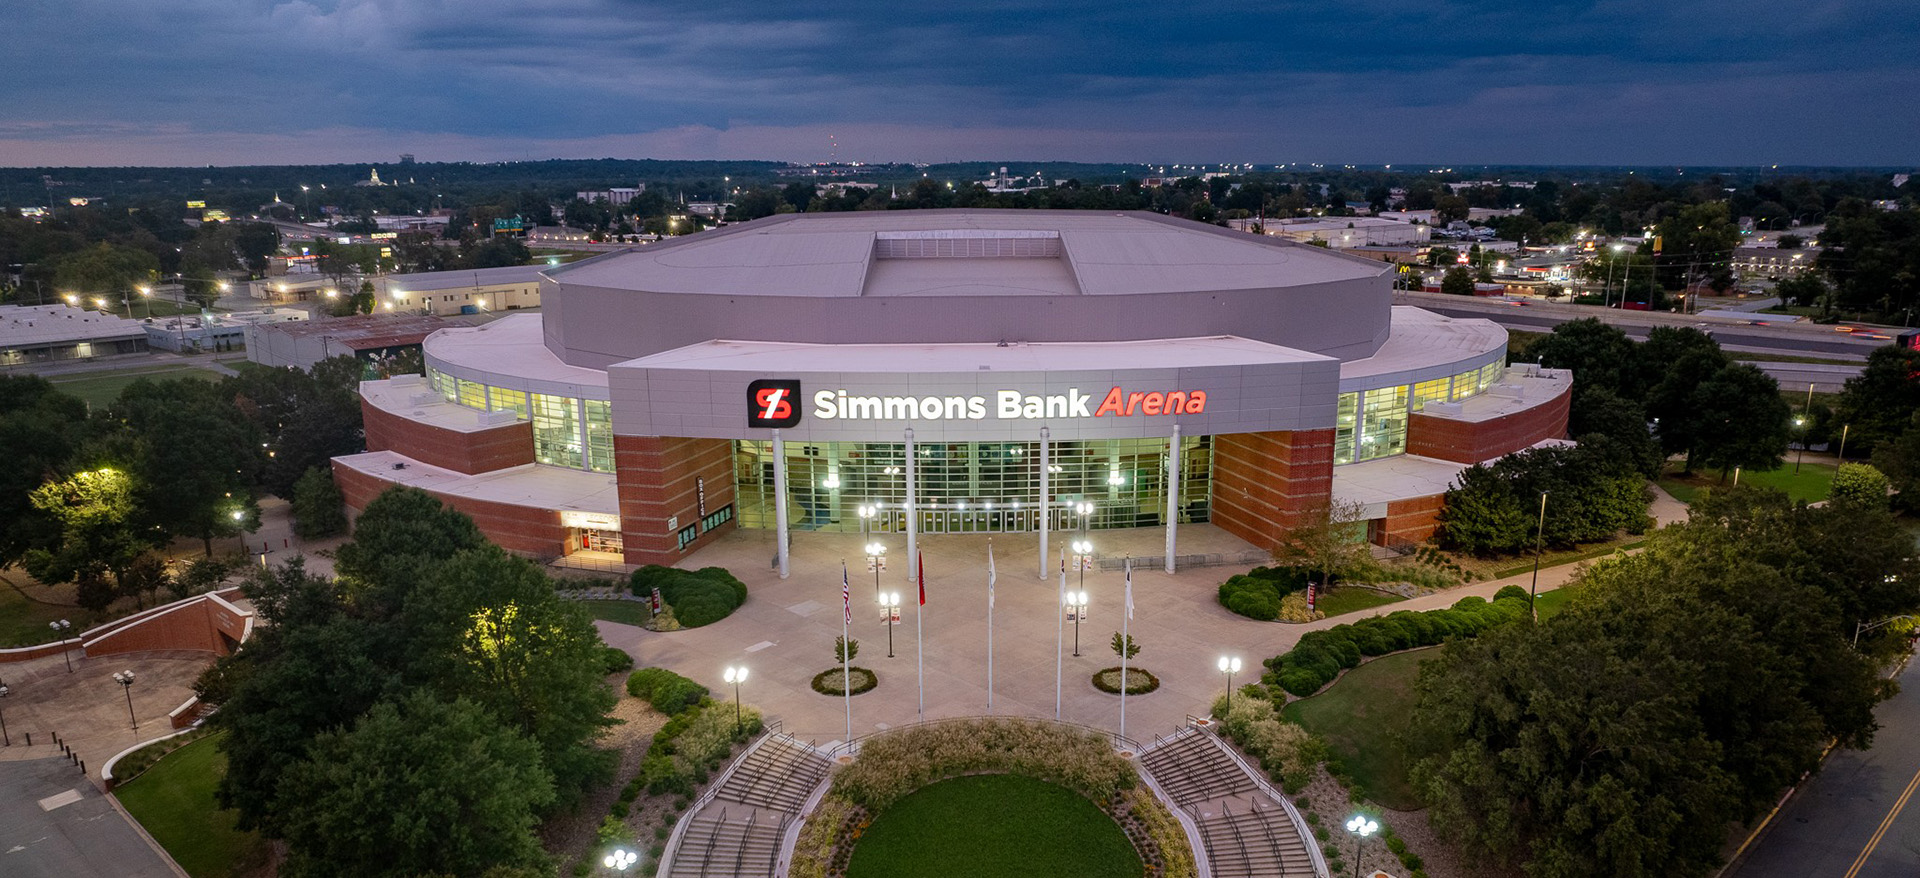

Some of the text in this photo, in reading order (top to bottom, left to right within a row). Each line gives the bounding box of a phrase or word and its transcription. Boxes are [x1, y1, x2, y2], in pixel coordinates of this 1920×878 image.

[813, 386, 1207, 420] Simmons Bank Arena
